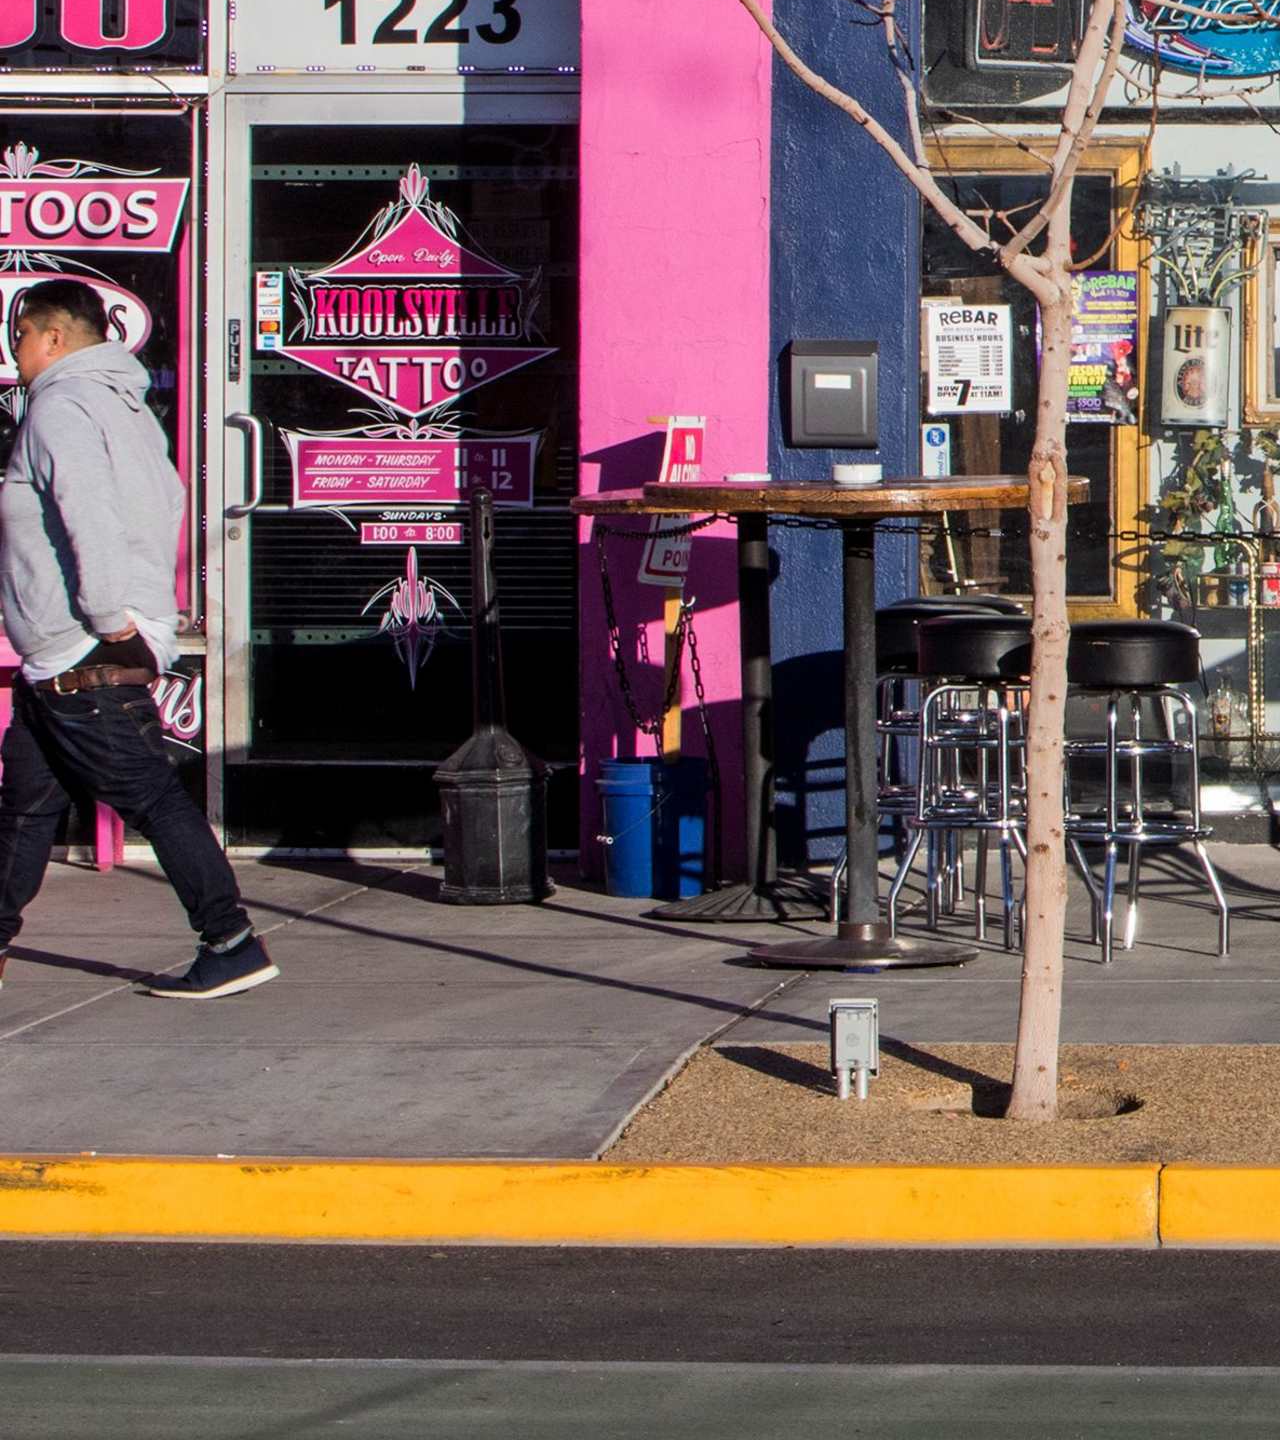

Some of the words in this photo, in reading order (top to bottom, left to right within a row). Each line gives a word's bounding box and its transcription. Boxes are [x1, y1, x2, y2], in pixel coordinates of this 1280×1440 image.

[369, 249, 406, 265] Open
[413, 249, 455, 267] Daily
[315, 289, 518, 337] KOOLSVILLE
[939, 310, 999, 326] ReBAR
[229, 322, 240, 370] PULL
[936, 334, 975, 342] BUSINESS
[977, 334, 1004, 342] HOURS
[336, 357, 488, 406] TATTOO
[954, 379, 972, 406] 7
[312, 476, 352, 489] FRIDAY
[366, 476, 430, 490] SATURDAY
[491, 471, 514, 490] 12
[425, 526, 455, 541] 8:00
